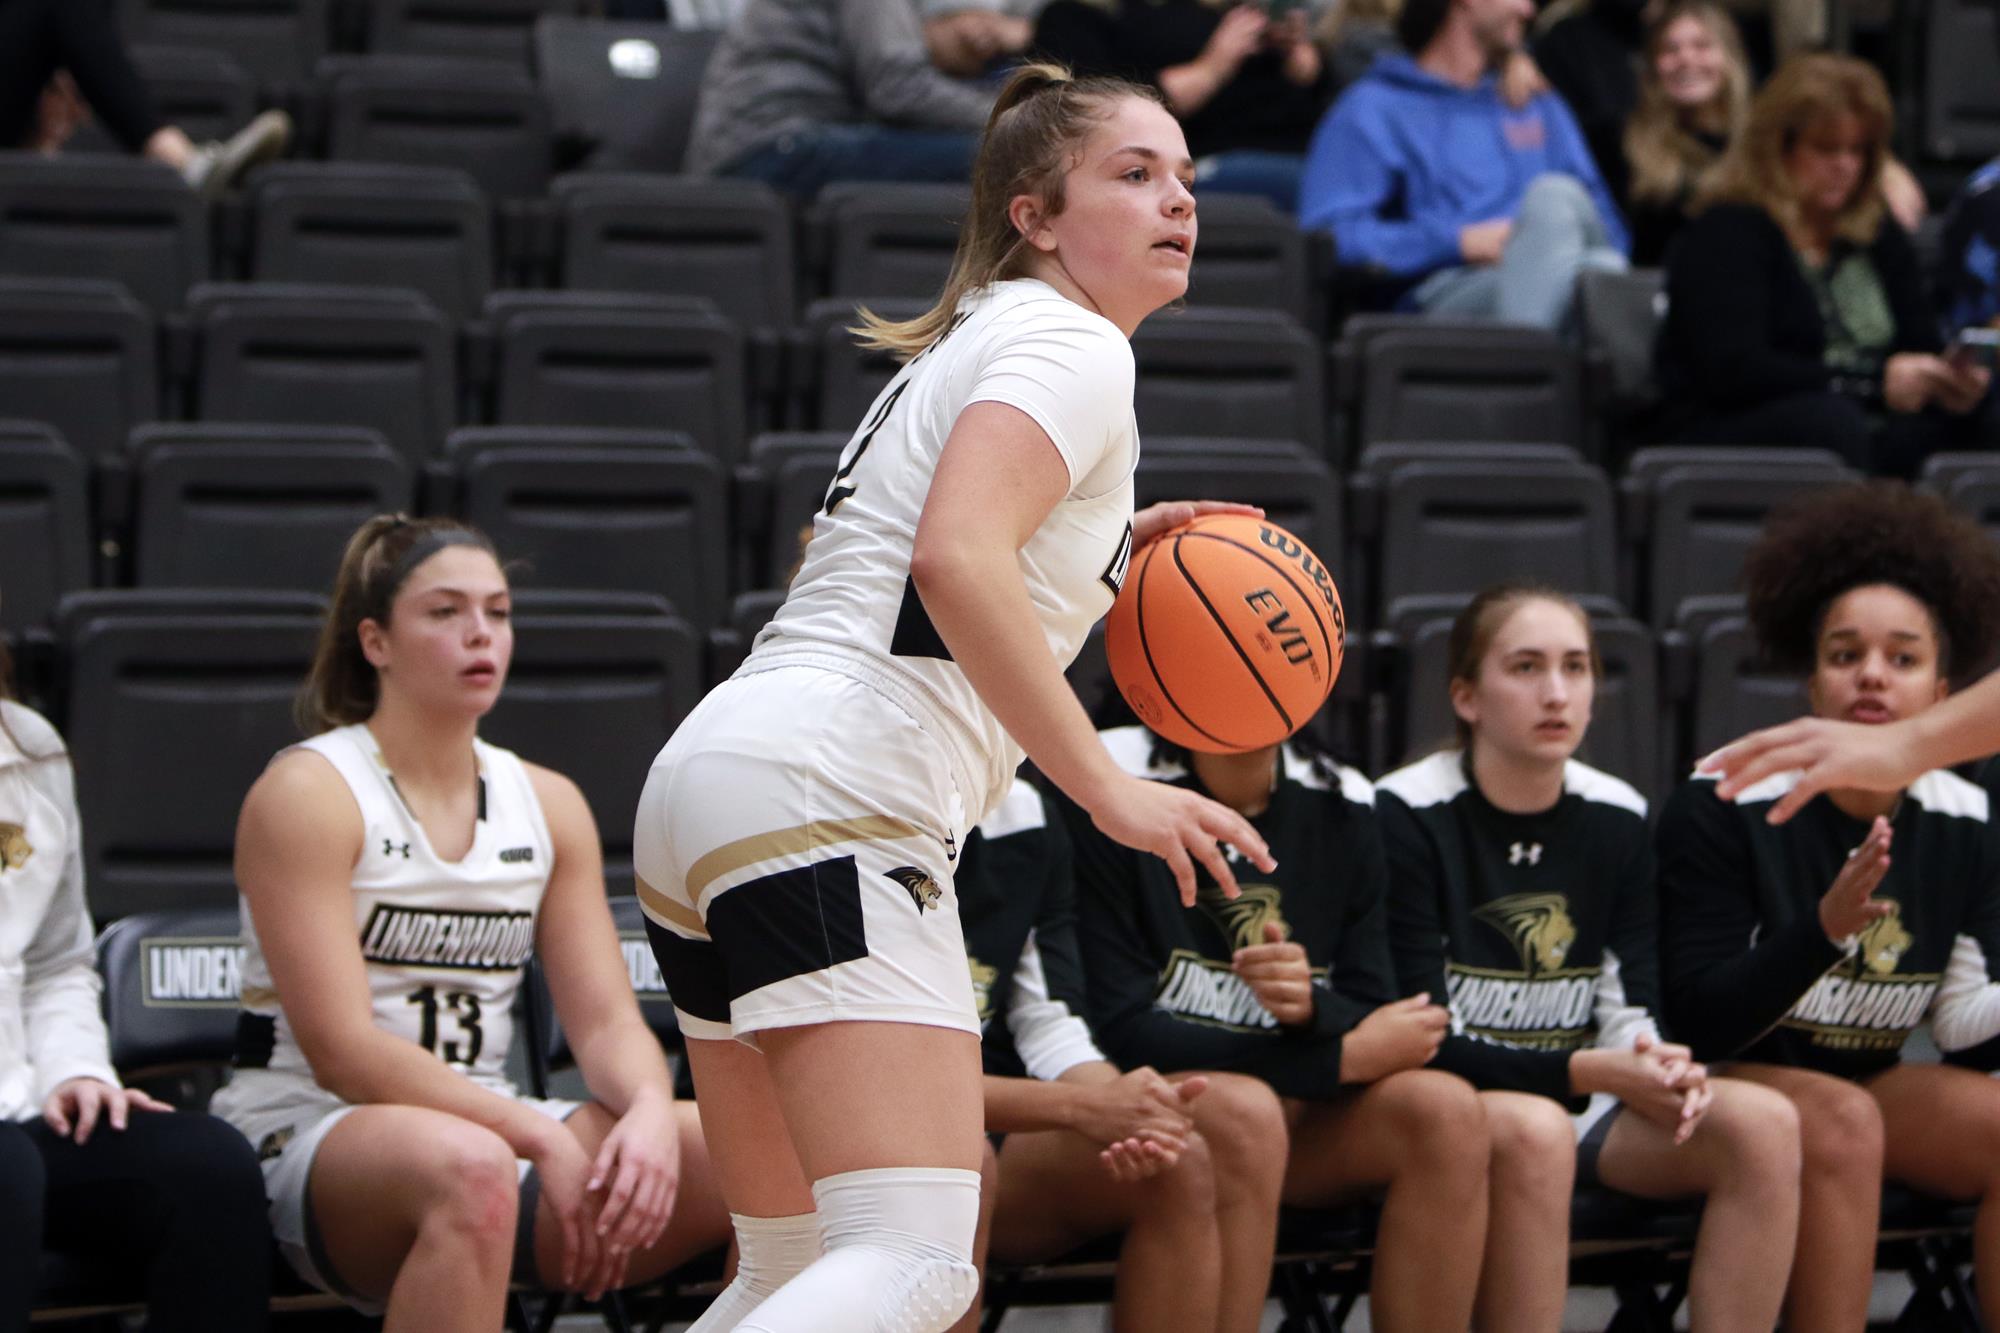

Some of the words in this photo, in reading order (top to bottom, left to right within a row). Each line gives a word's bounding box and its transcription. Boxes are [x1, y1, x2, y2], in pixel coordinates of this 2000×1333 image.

[1244, 590, 1313, 665] EVO
[150, 946, 245, 999] LINDEN
[364, 909, 533, 967] LINDENWOOD
[407, 986, 482, 1066] 13
[1157, 959, 1279, 1028] LINDENW
